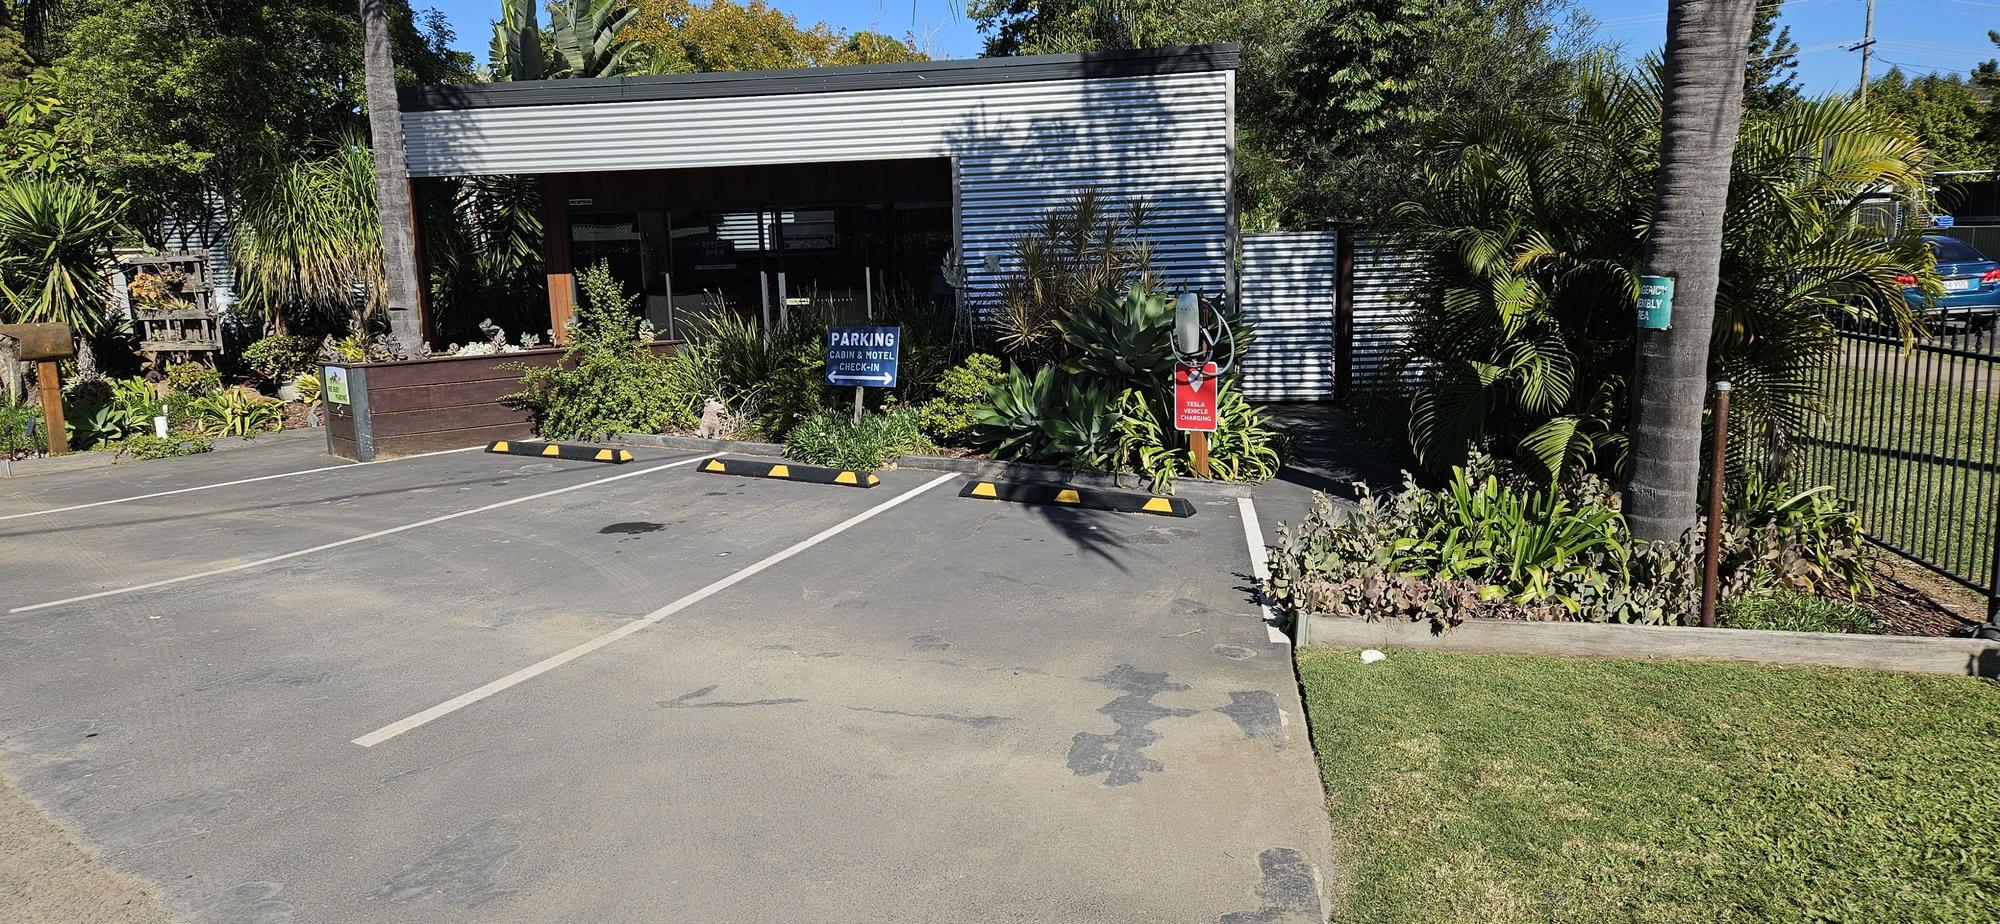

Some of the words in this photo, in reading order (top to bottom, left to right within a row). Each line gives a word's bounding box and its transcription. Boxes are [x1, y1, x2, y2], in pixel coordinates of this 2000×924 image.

[831, 332, 895, 347] PARKING
[829, 350, 855, 359] CABIN
[857, 351, 863, 360] &
[865, 351, 895, 360] MOTEL
[840, 362, 880, 371] CHECK-IN
